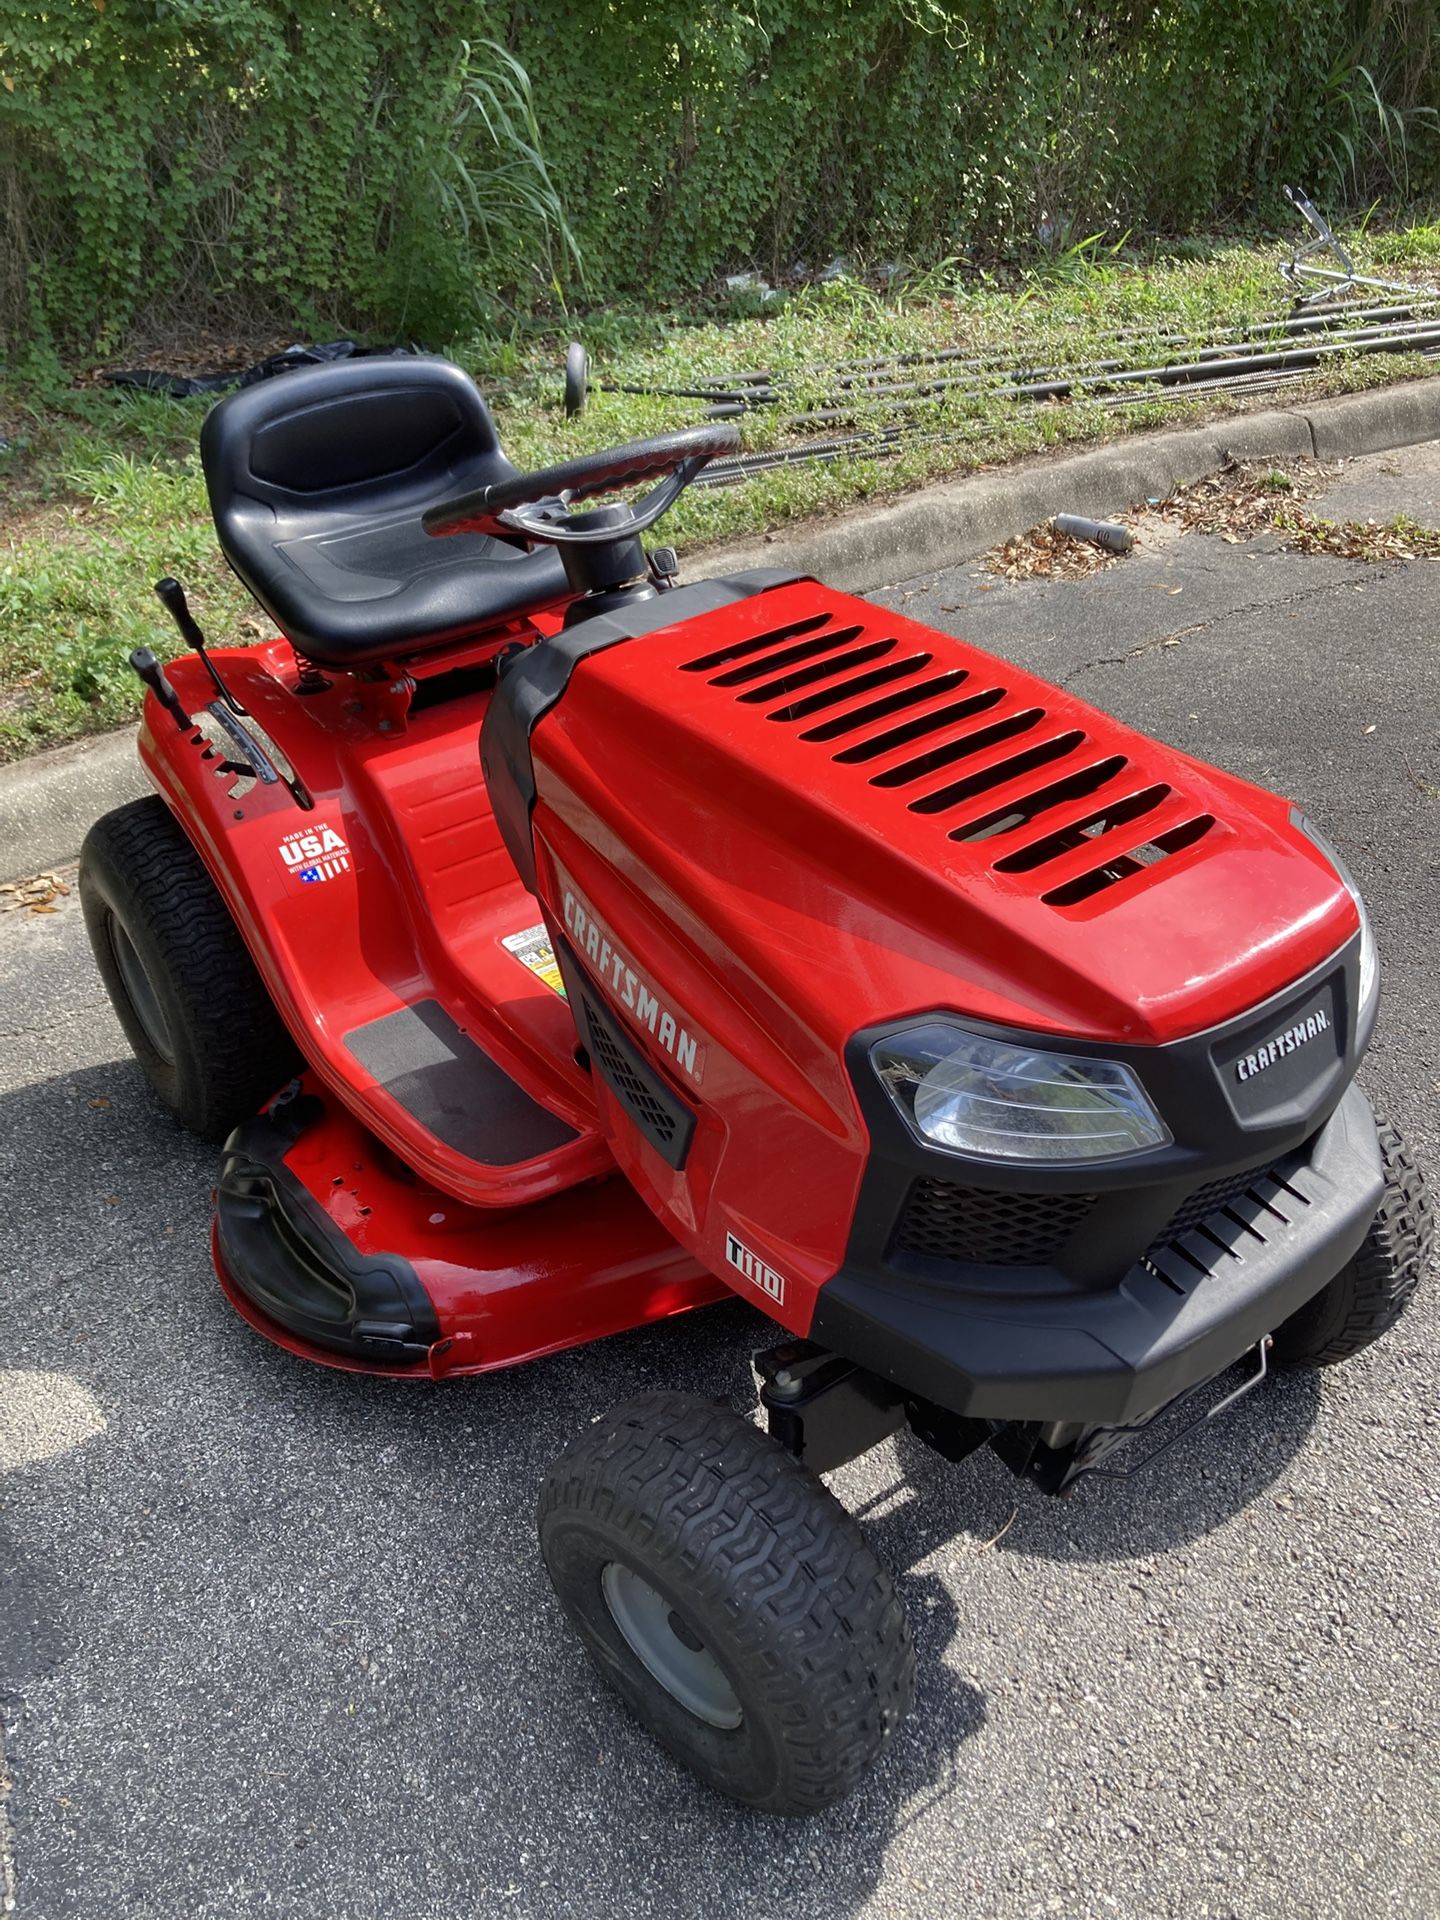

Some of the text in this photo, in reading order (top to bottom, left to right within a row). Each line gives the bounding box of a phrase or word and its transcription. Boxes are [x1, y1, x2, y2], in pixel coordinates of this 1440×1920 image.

[278, 829, 346, 866] USA
[282, 832, 304, 843] MADE
[314, 823, 329, 832] THE
[288, 848, 350, 874] WITH GLOBAL MATERIALS
[563, 891, 698, 1076] CRAFTSMAN
[1236, 1009, 1328, 1081] CRAFTSMAN
[728, 1235, 780, 1299] T110
